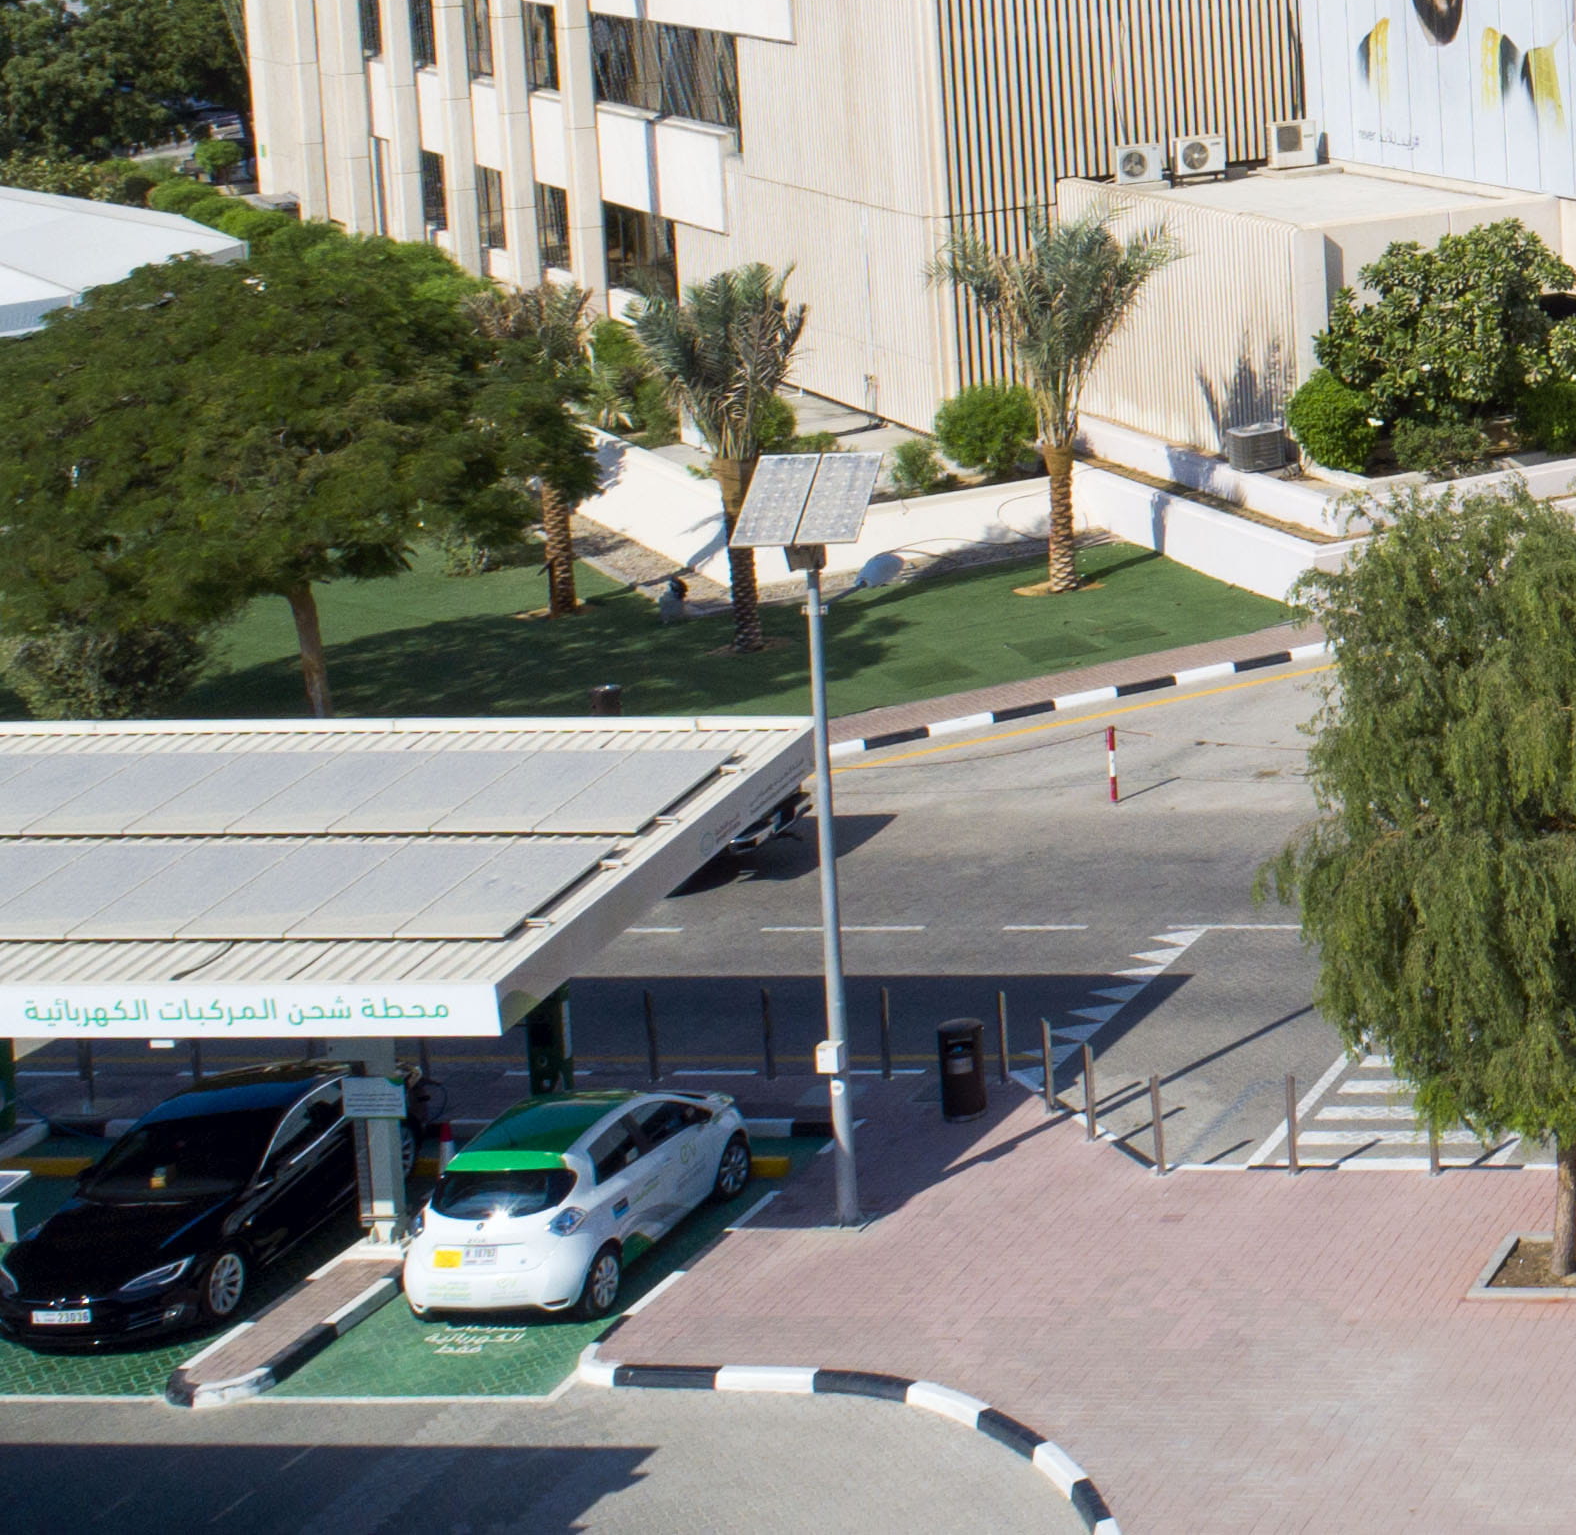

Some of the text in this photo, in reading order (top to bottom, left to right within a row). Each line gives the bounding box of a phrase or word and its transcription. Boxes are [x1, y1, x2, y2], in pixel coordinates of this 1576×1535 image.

[24, 995, 450, 1028] محطة شحن المركبات الكهربائية
